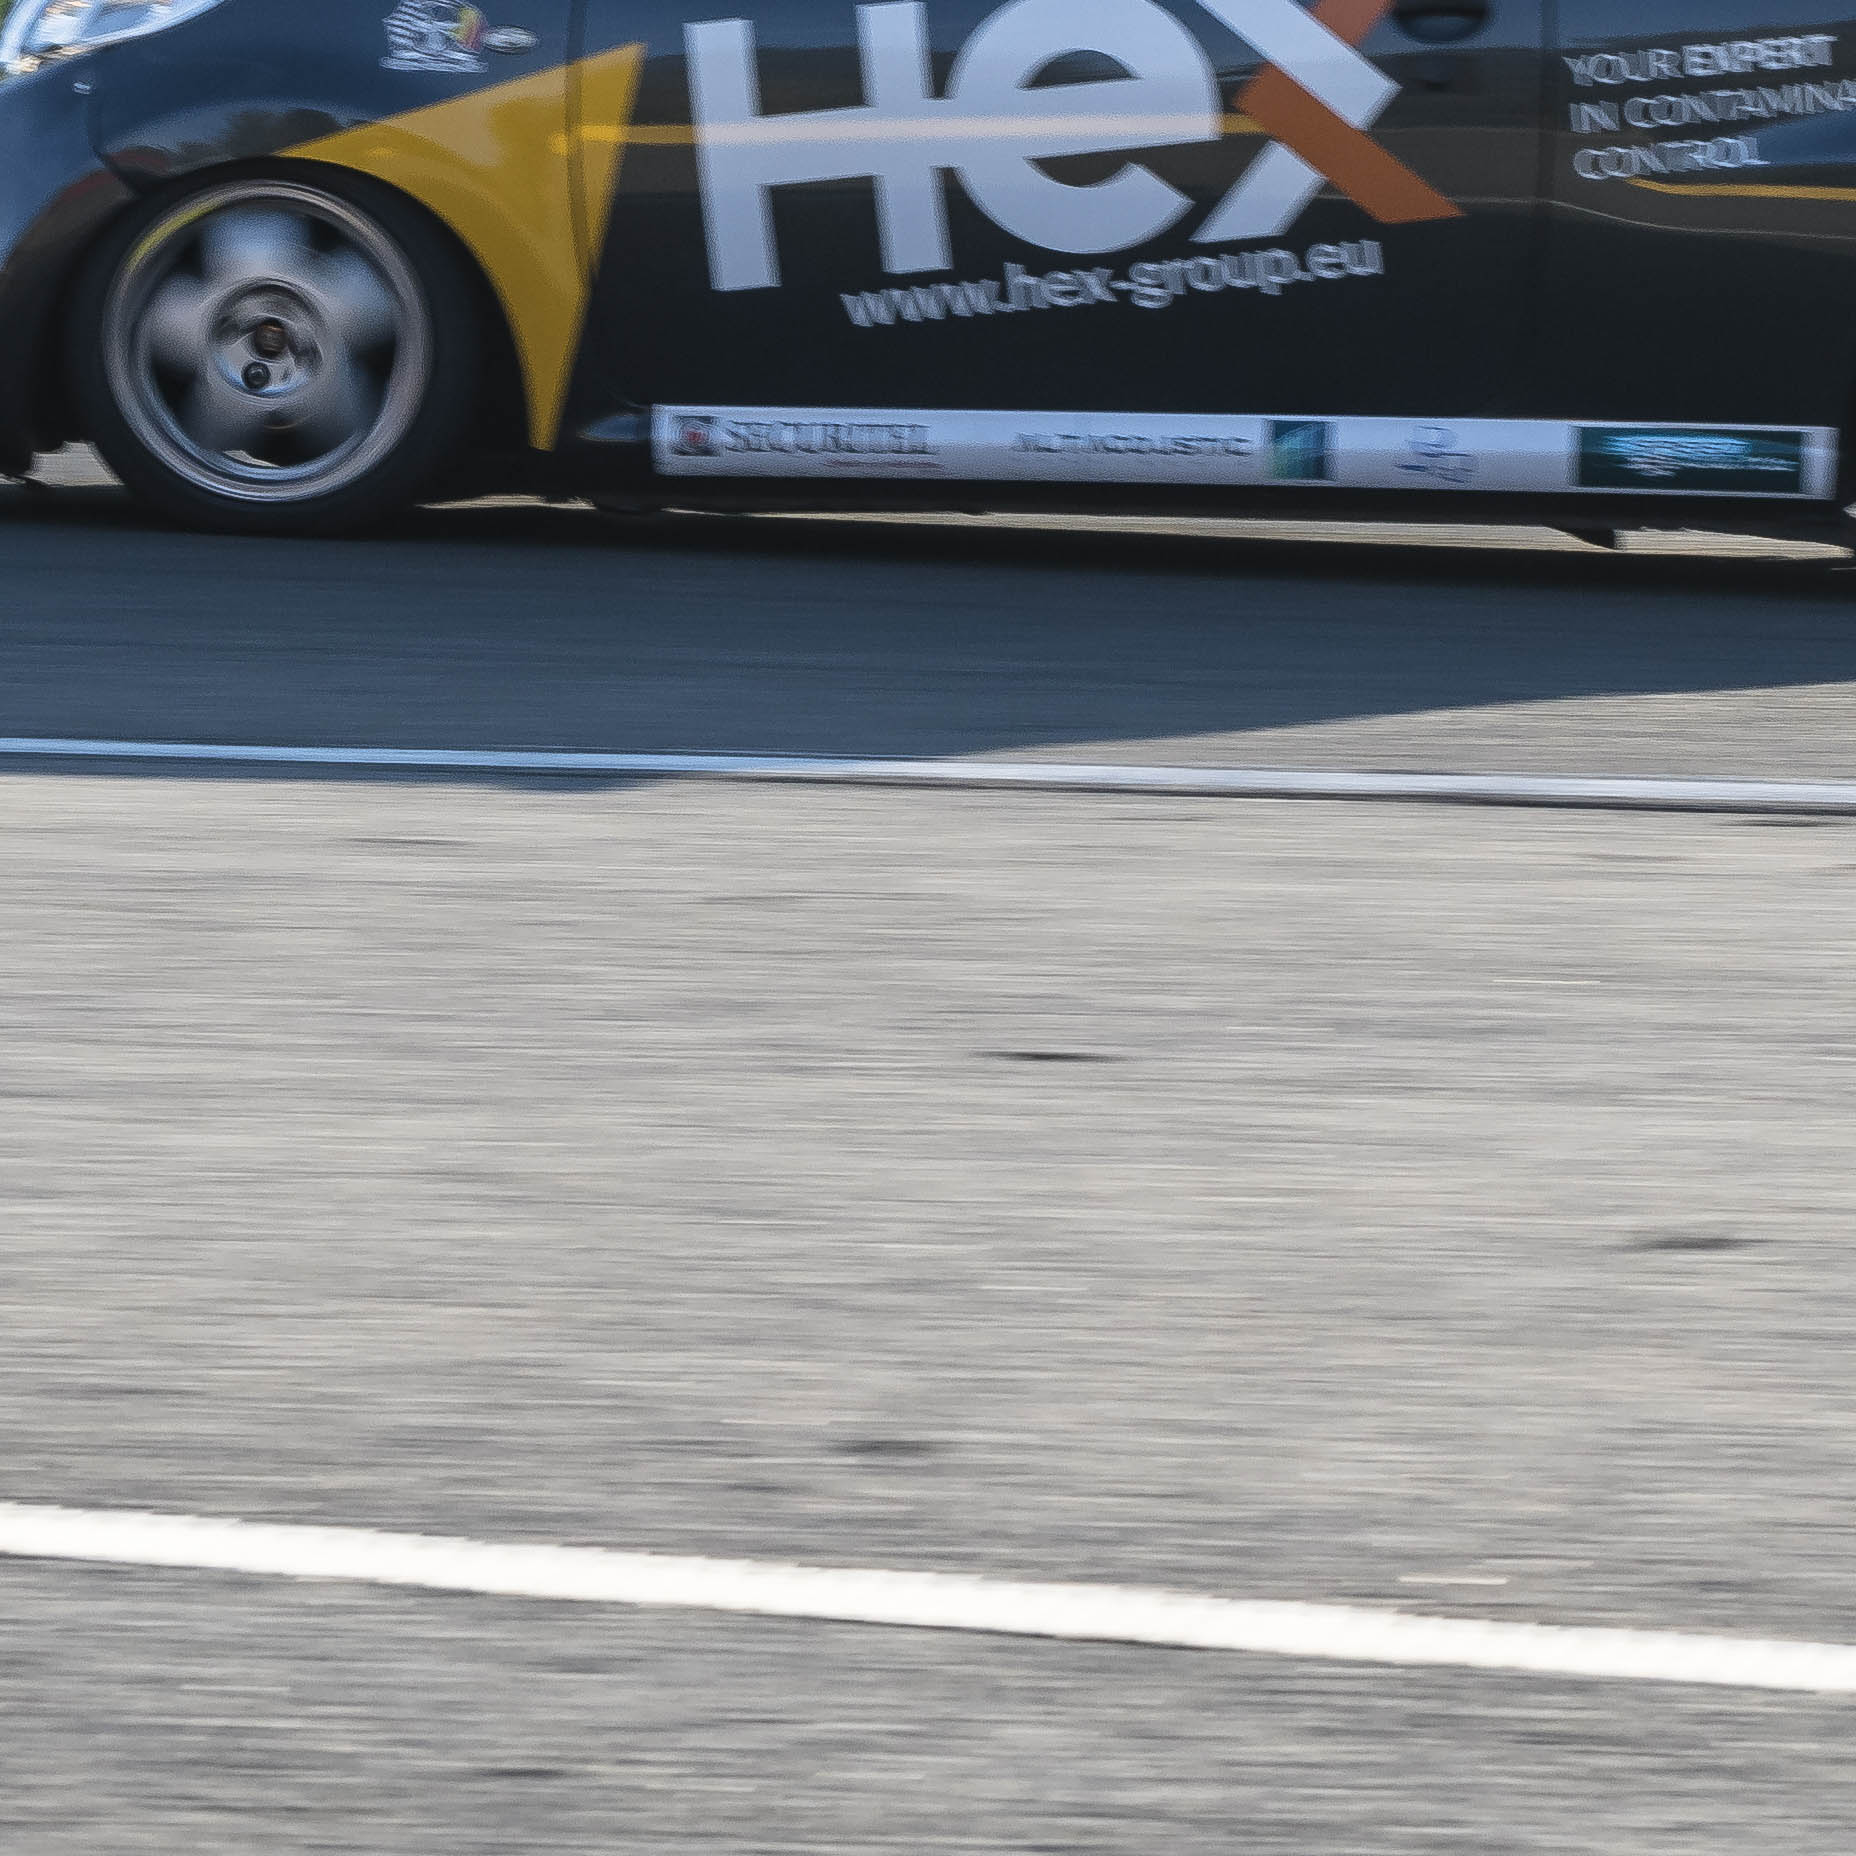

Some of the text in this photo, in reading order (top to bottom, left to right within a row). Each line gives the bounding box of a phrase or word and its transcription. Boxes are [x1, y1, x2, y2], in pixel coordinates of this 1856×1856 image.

[1562, 34, 1838, 86] YOUR EXPERT
[1569, 100, 1620, 134] IN
[1573, 135, 1768, 180] CONTROL
[840, 240, 1385, 327] www.hex-group.eu
